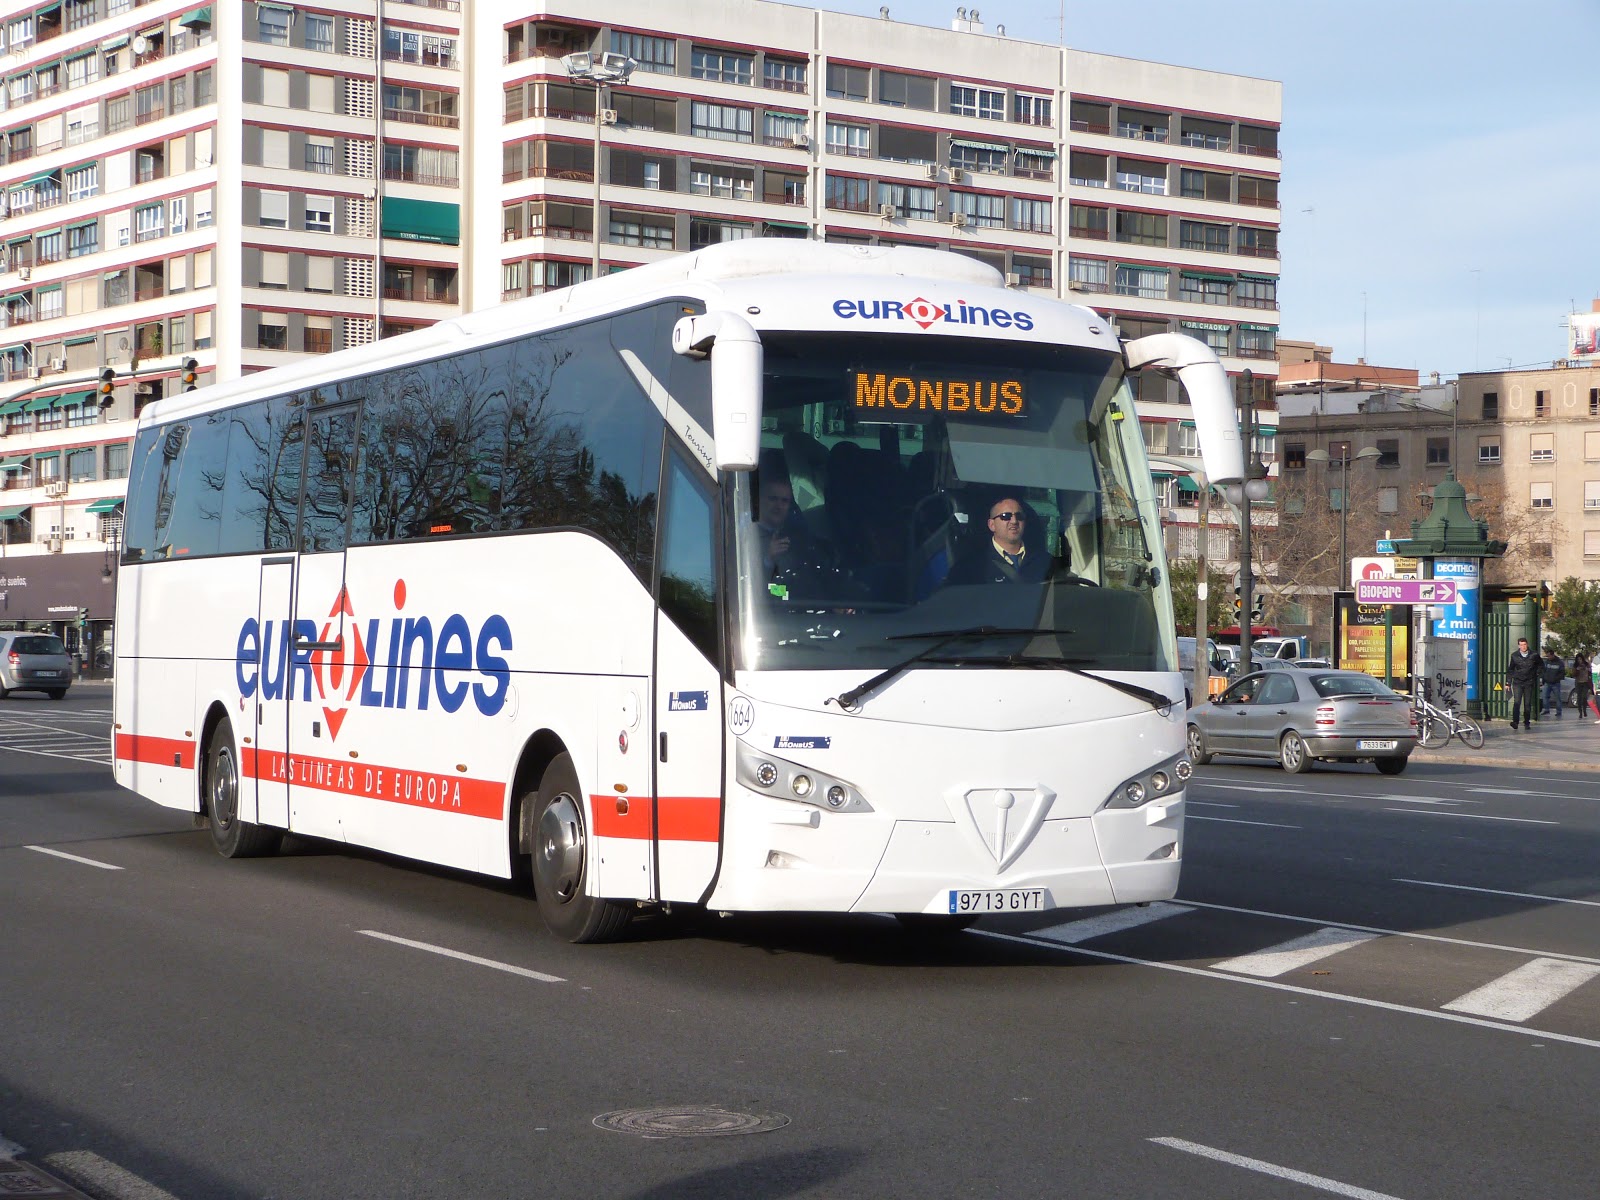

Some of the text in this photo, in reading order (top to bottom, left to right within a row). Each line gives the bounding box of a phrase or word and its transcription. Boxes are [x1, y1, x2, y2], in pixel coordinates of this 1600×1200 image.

[856, 373, 1023, 414] MONBUS
[685, 425, 713, 469] Touring
[1436, 631, 1477, 640] andando
[1450, 618, 1476, 629] min.
[730, 703, 750, 727] 1664
[272, 756, 295, 780] LAS
[365, 769, 383, 795] DE
[394, 773, 462, 808] EUROPA
[960, 891, 1042, 911] 9713 GYT
